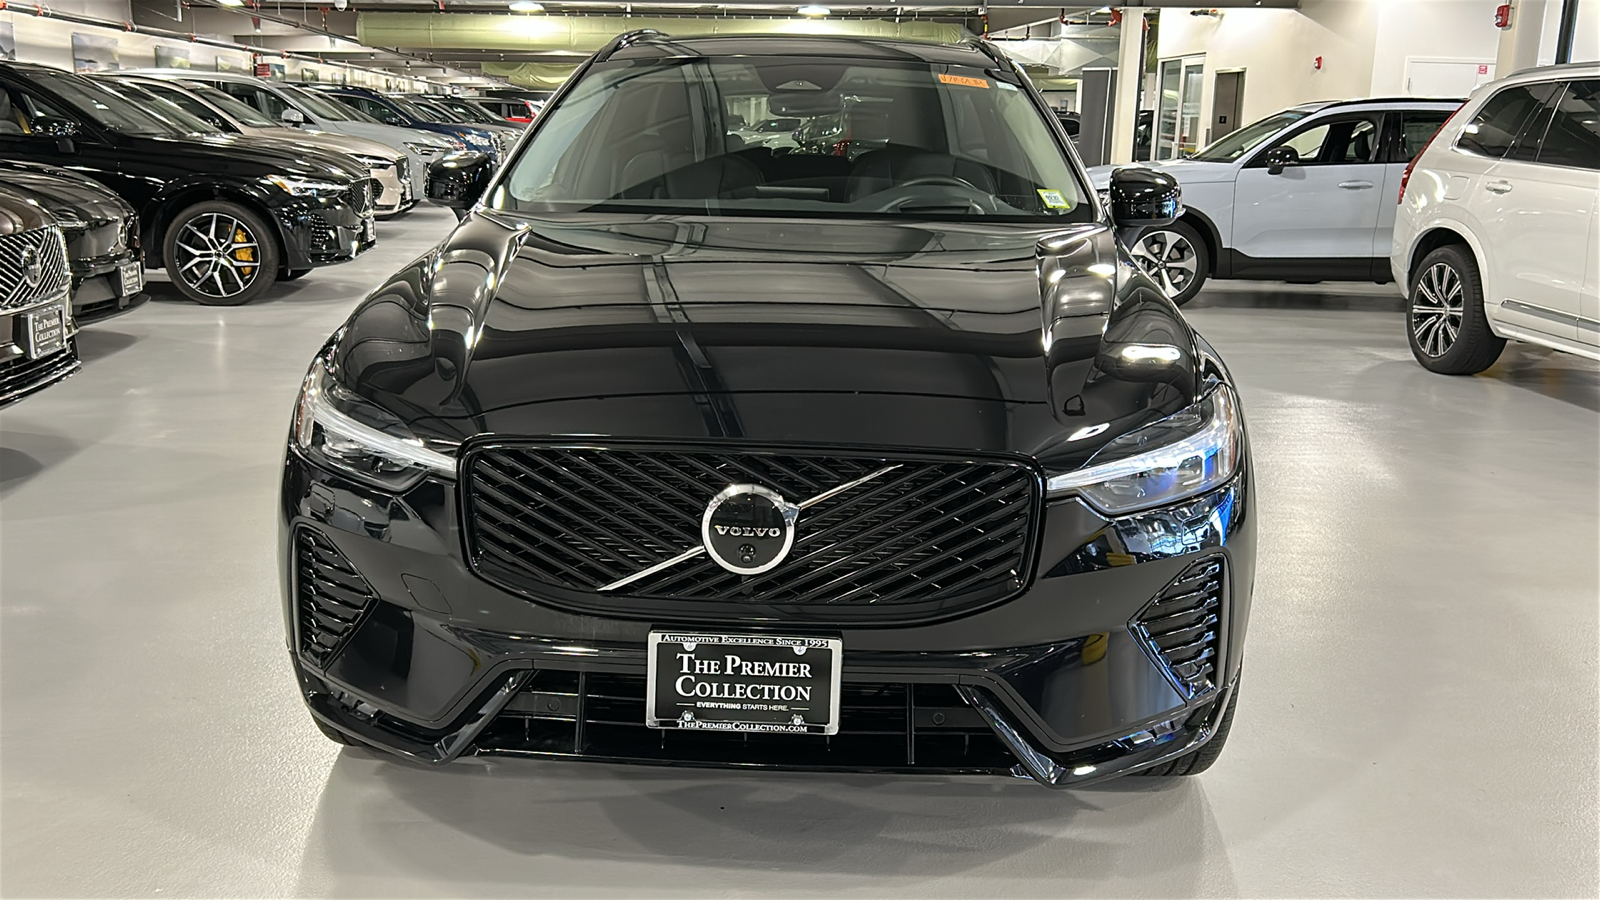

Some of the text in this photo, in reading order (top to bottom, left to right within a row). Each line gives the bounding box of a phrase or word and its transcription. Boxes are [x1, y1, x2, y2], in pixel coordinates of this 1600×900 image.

[714, 524, 781, 537] VOLVO
[663, 634, 828, 647] AUTOMOTIVE EXCELLENCE SINCE 1995
[676, 652, 812, 678] THE PREMIER
[675, 675, 812, 701] COLLECTION
[696, 701, 741, 710] EVERYTHING
